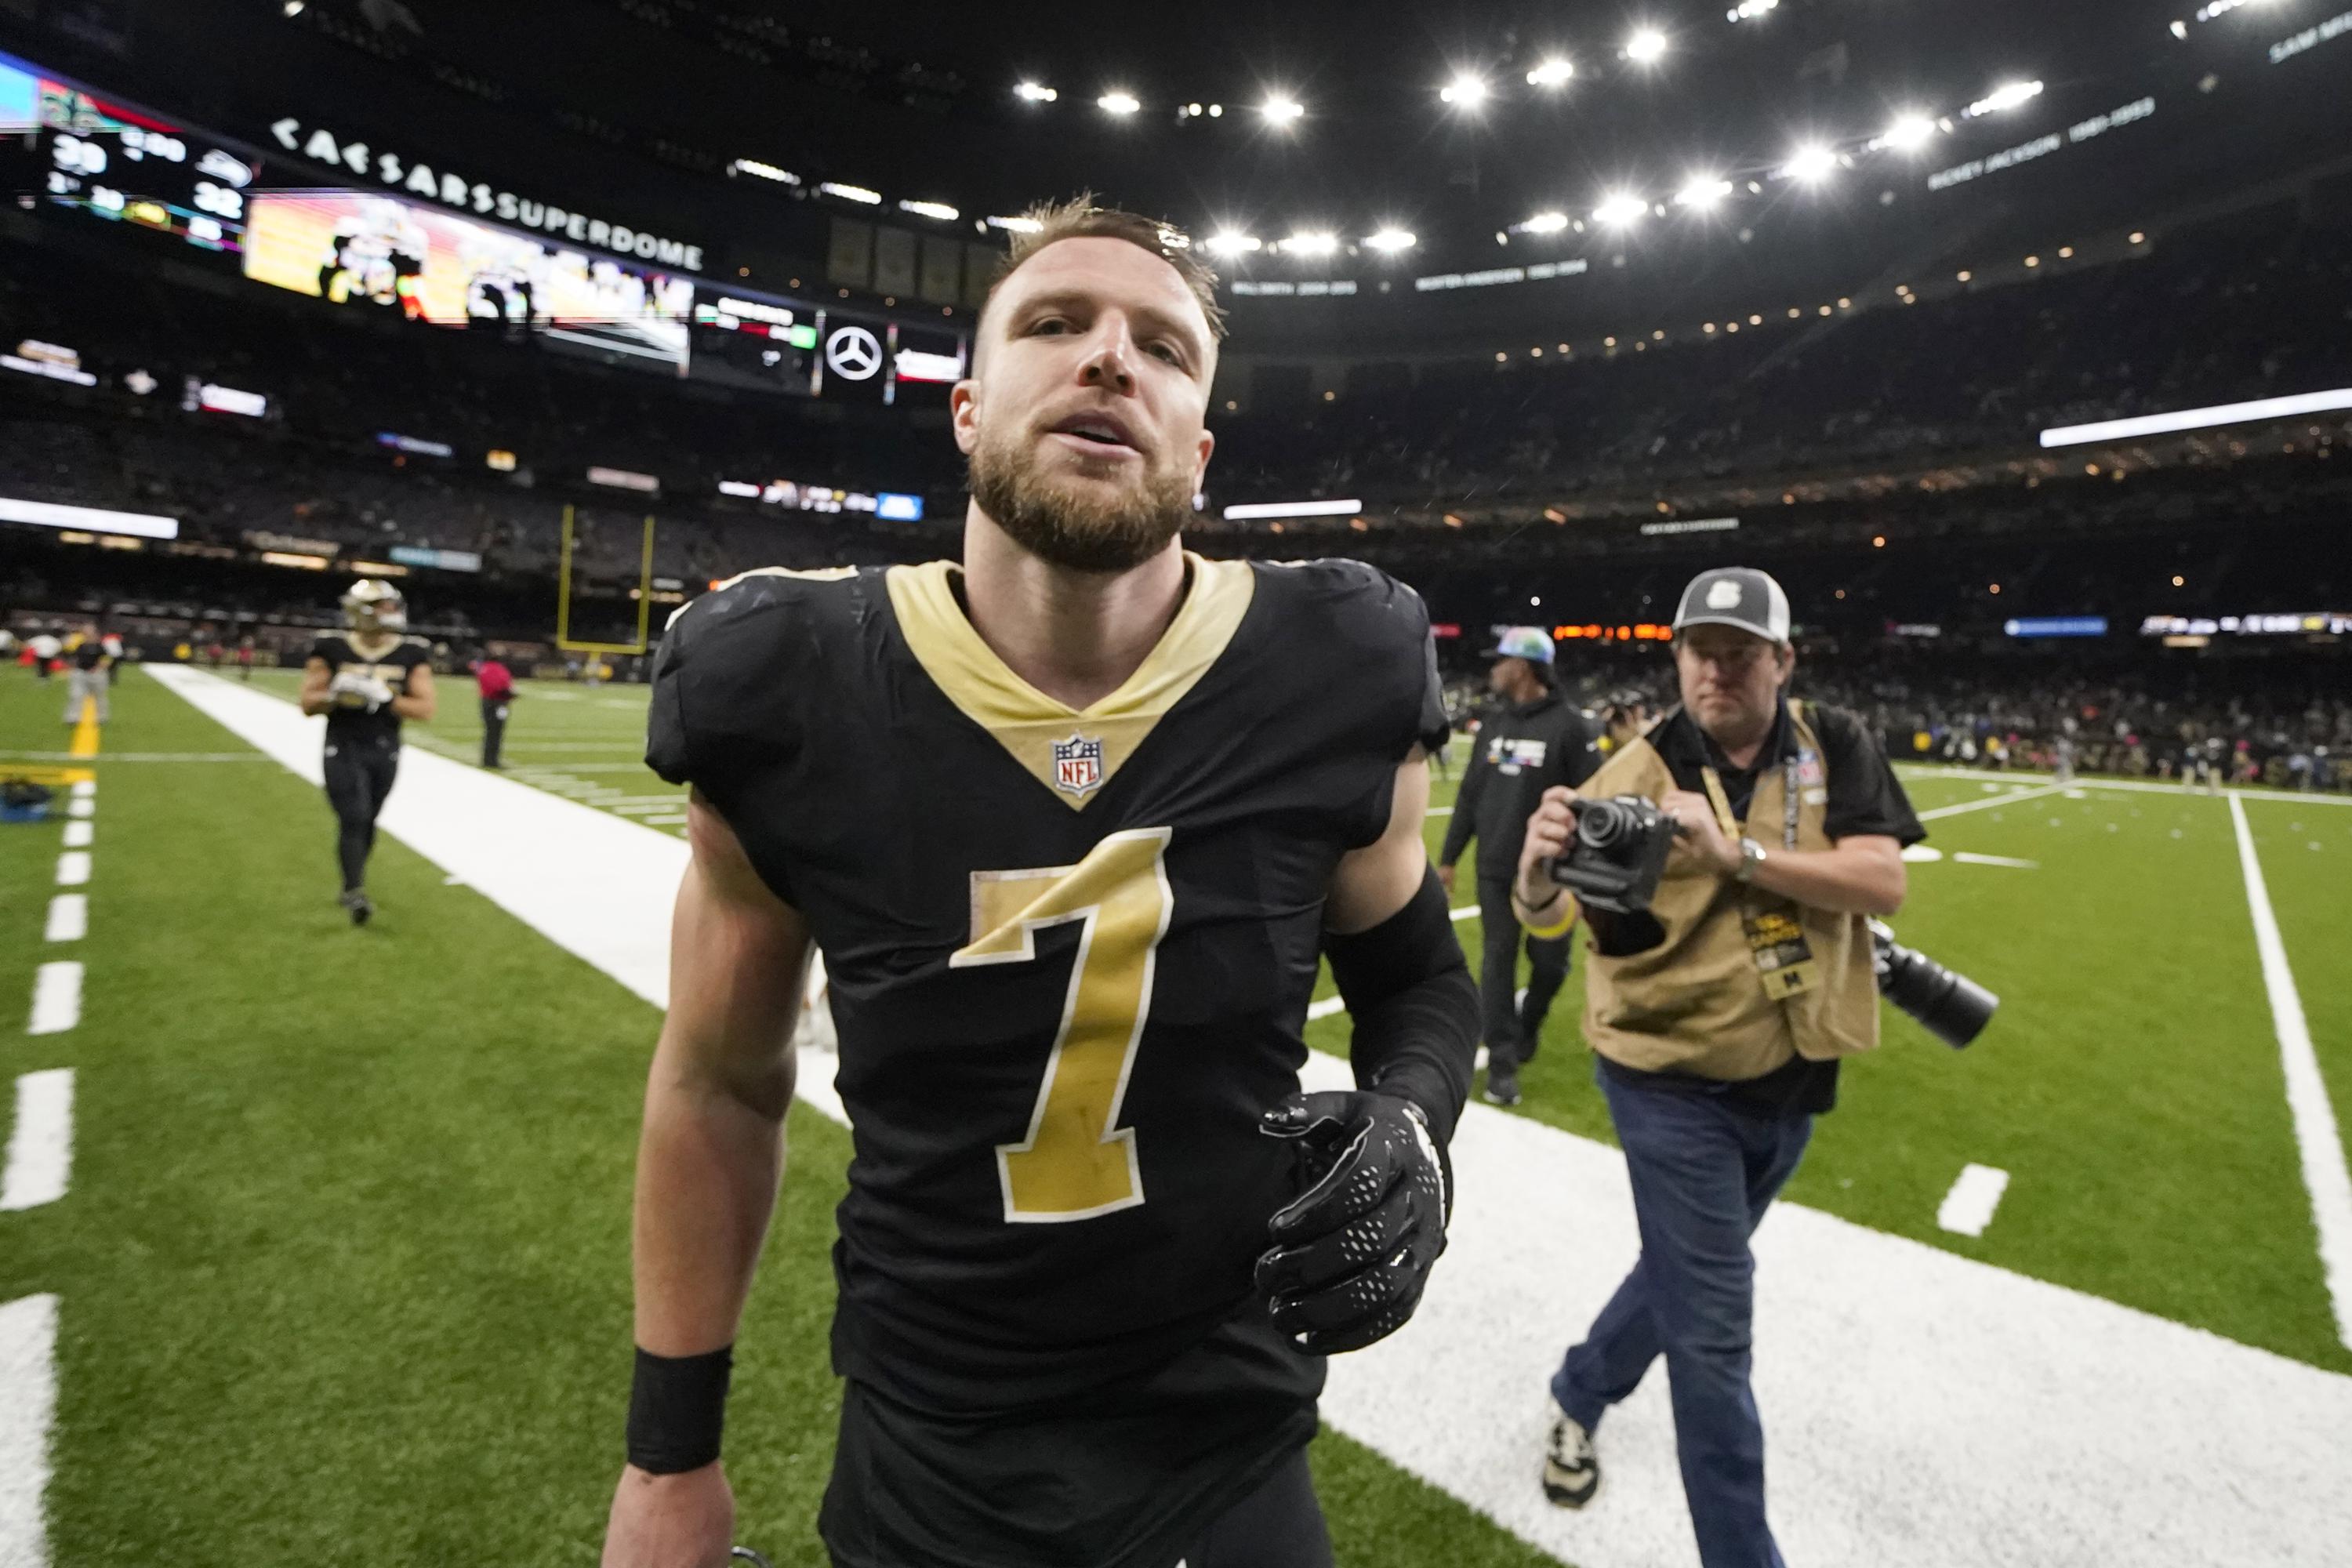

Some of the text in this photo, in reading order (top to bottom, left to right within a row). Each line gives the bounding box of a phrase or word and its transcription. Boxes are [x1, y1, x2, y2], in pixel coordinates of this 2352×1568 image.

[271, 118, 495, 212] CAESARS
[495, 192, 702, 270] SUPERDOME
[1061, 760, 1097, 786] NFL
[949, 826, 1174, 1223] 7
